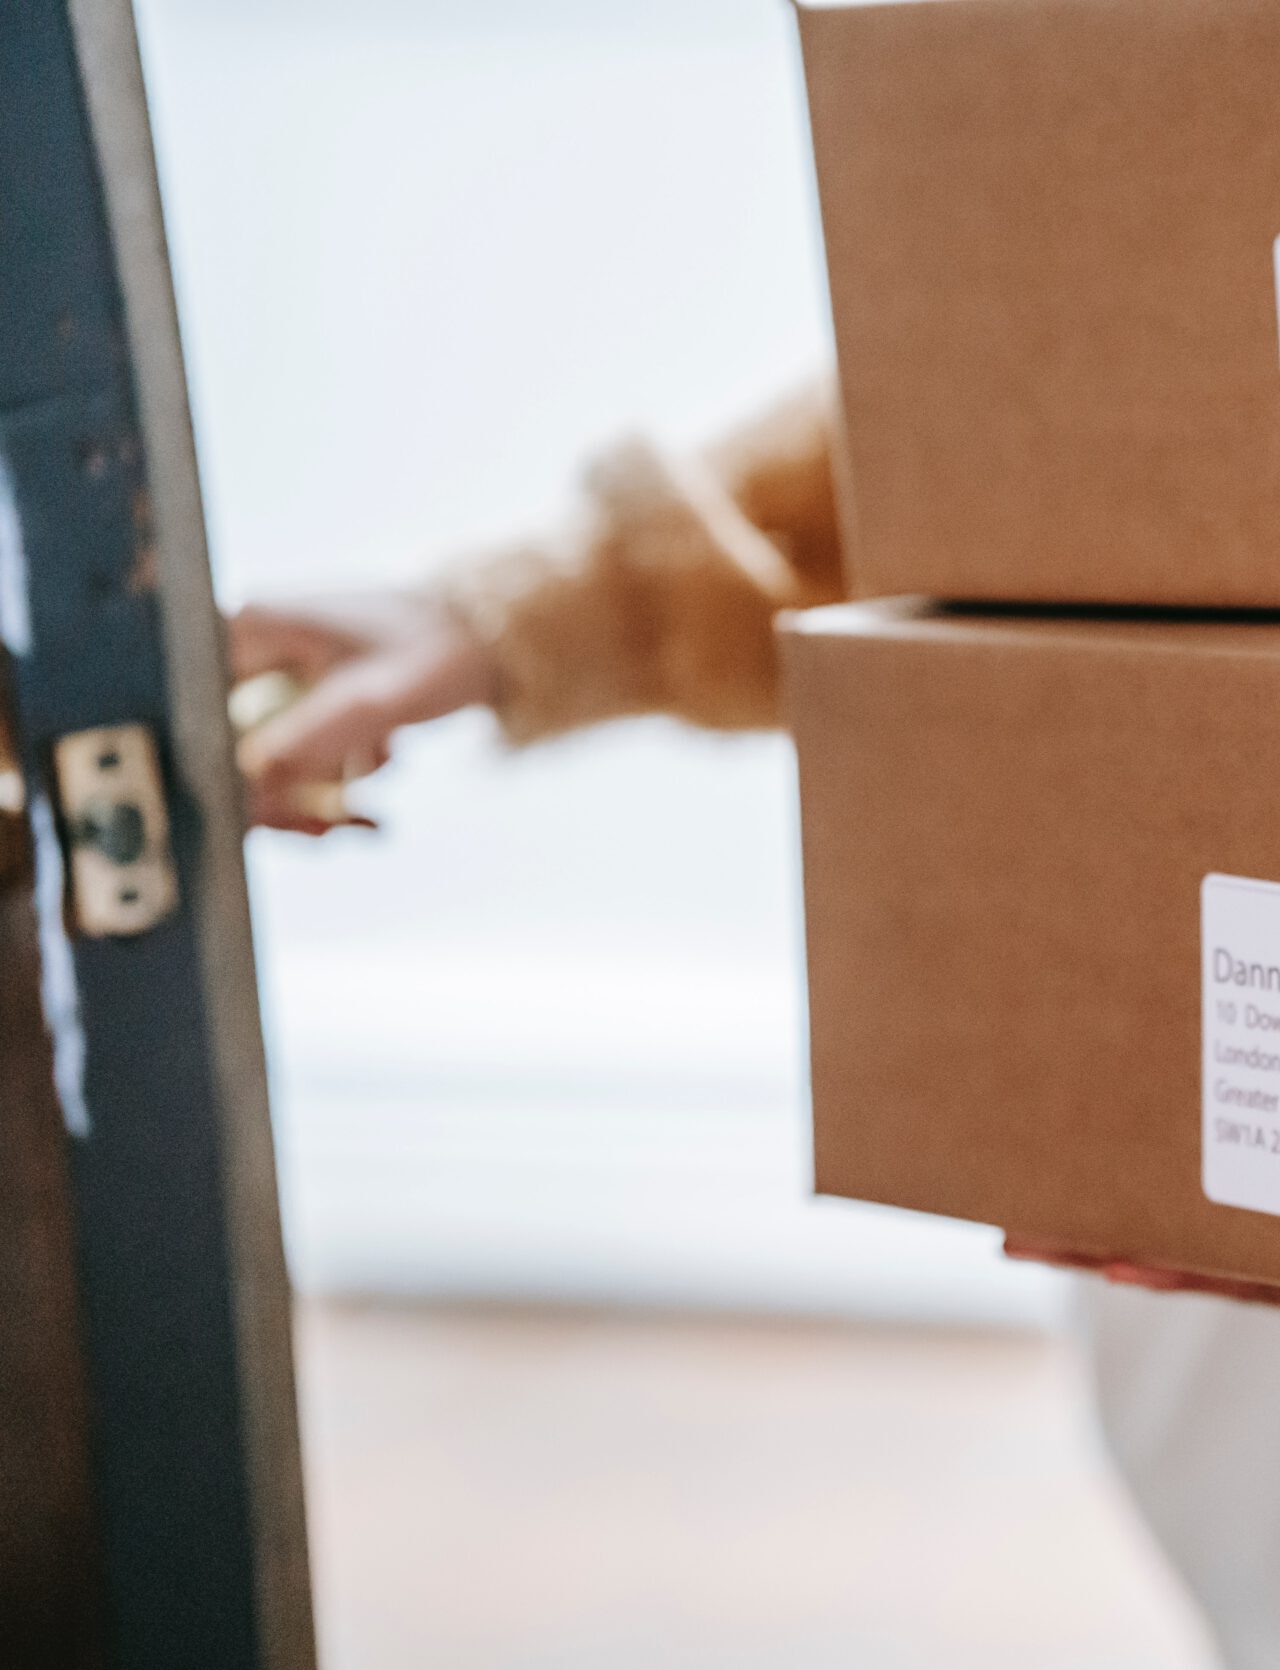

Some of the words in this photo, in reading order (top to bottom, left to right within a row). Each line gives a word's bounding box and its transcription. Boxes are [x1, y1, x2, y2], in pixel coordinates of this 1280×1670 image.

[1216, 1002, 1237, 1025] 10
[1214, 1080, 1278, 1112] Greater
[1215, 1119, 1266, 1149] SW1A
